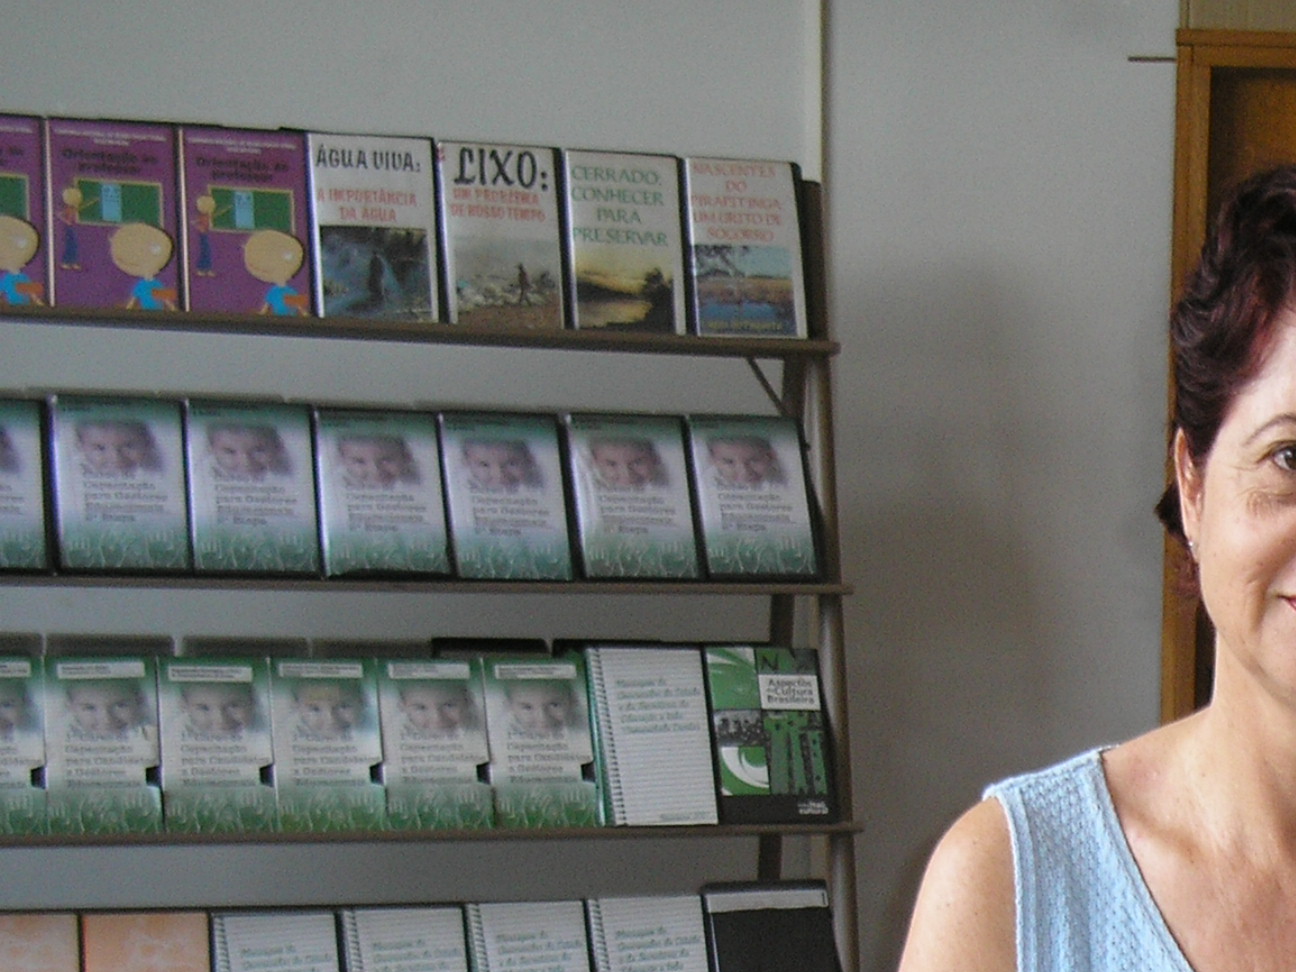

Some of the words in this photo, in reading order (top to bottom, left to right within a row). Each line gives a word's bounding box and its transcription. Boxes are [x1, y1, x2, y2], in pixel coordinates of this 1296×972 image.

[316, 144, 368, 170] ÁGUA
[454, 147, 548, 191] LIXO:
[571, 187, 664, 206] CONHECER
[597, 207, 641, 223] PARA
[573, 227, 668, 246] PRESERVAR
